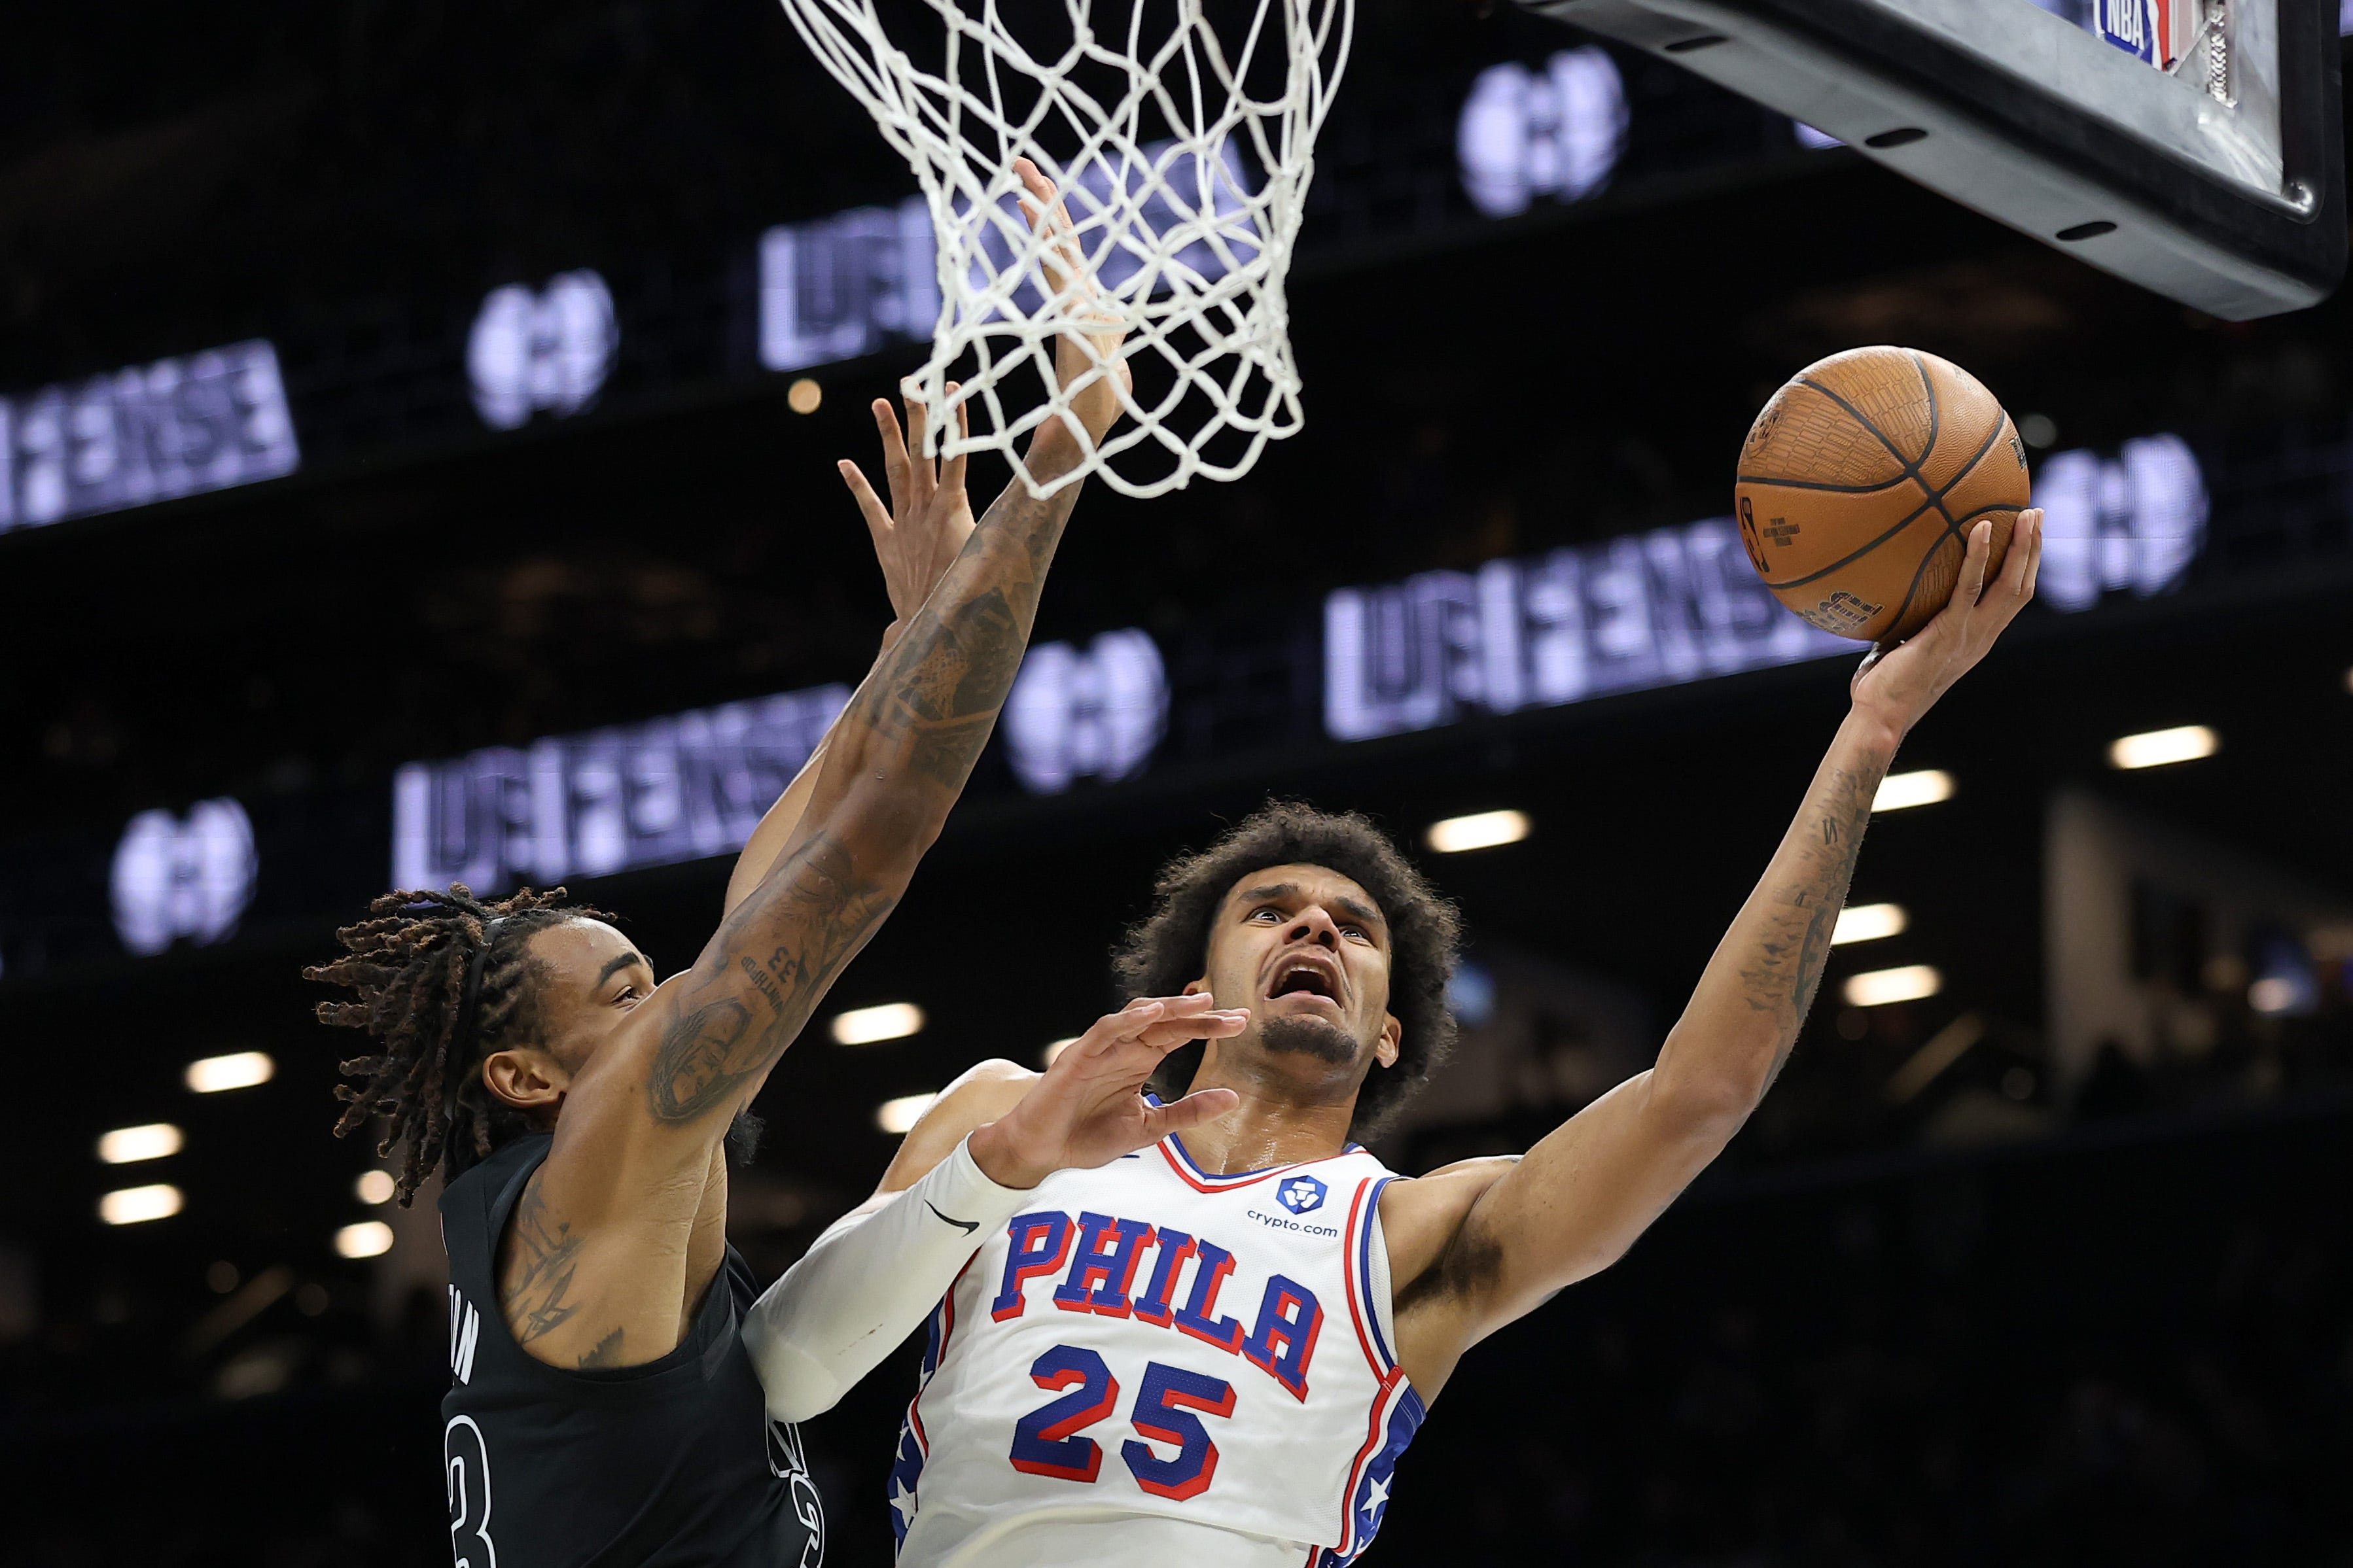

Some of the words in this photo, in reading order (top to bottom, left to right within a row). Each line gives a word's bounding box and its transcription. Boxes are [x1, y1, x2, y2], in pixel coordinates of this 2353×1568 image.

[2107, 0, 2145, 50] NBA
[768, 946, 796, 983] 33
[1247, 1210, 1338, 1238] crypto.com
[991, 1210, 1325, 1403] PHILA
[1009, 1344, 1237, 1502] 25
